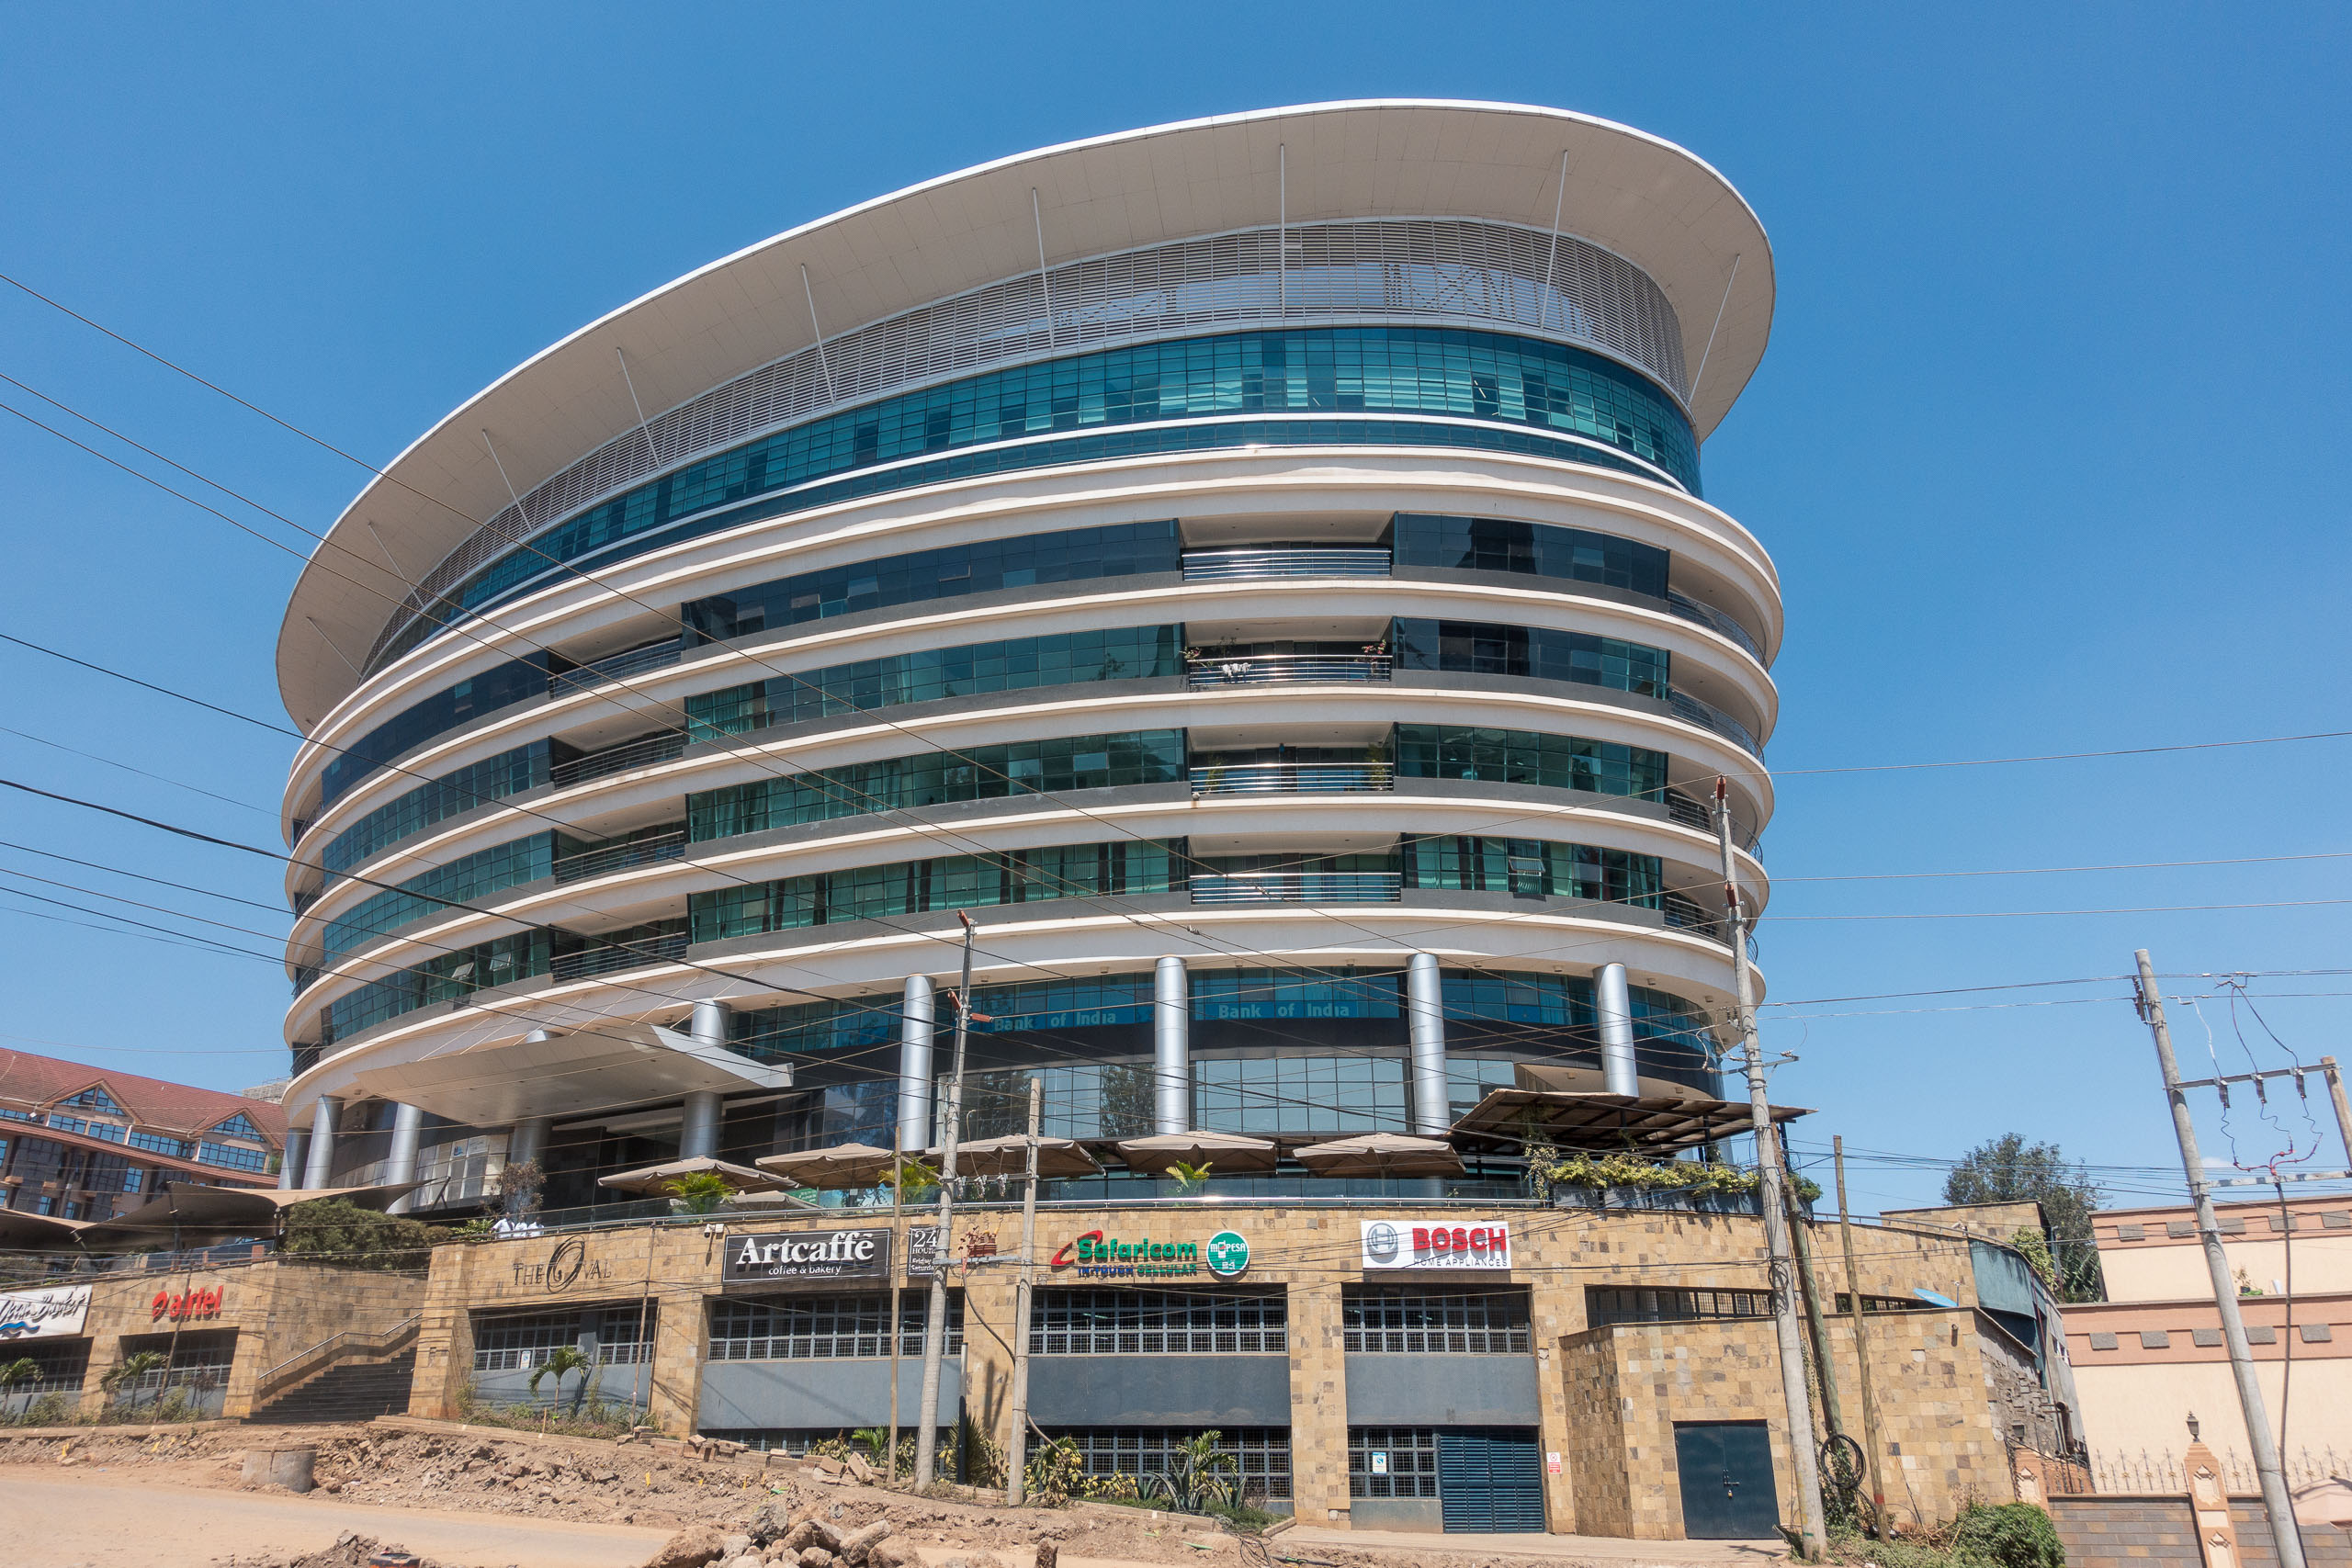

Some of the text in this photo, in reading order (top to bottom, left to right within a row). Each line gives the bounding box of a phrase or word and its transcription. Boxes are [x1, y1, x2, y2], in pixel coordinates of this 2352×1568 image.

[1218, 1003, 1350, 1019] Bank of India
[994, 1010, 1116, 1031] Bank of India
[912, 1229, 938, 1247] 24
[1412, 1227, 1507, 1251] BOSCH
[1078, 1238, 1198, 1258] Safaricom
[768, 1264, 842, 1276] coffee & bakery
[1136, 1264, 1198, 1274] CELLULAR
[1413, 1258, 1508, 1267] HOME APPLIANCES
[514, 1262, 544, 1286] THE
